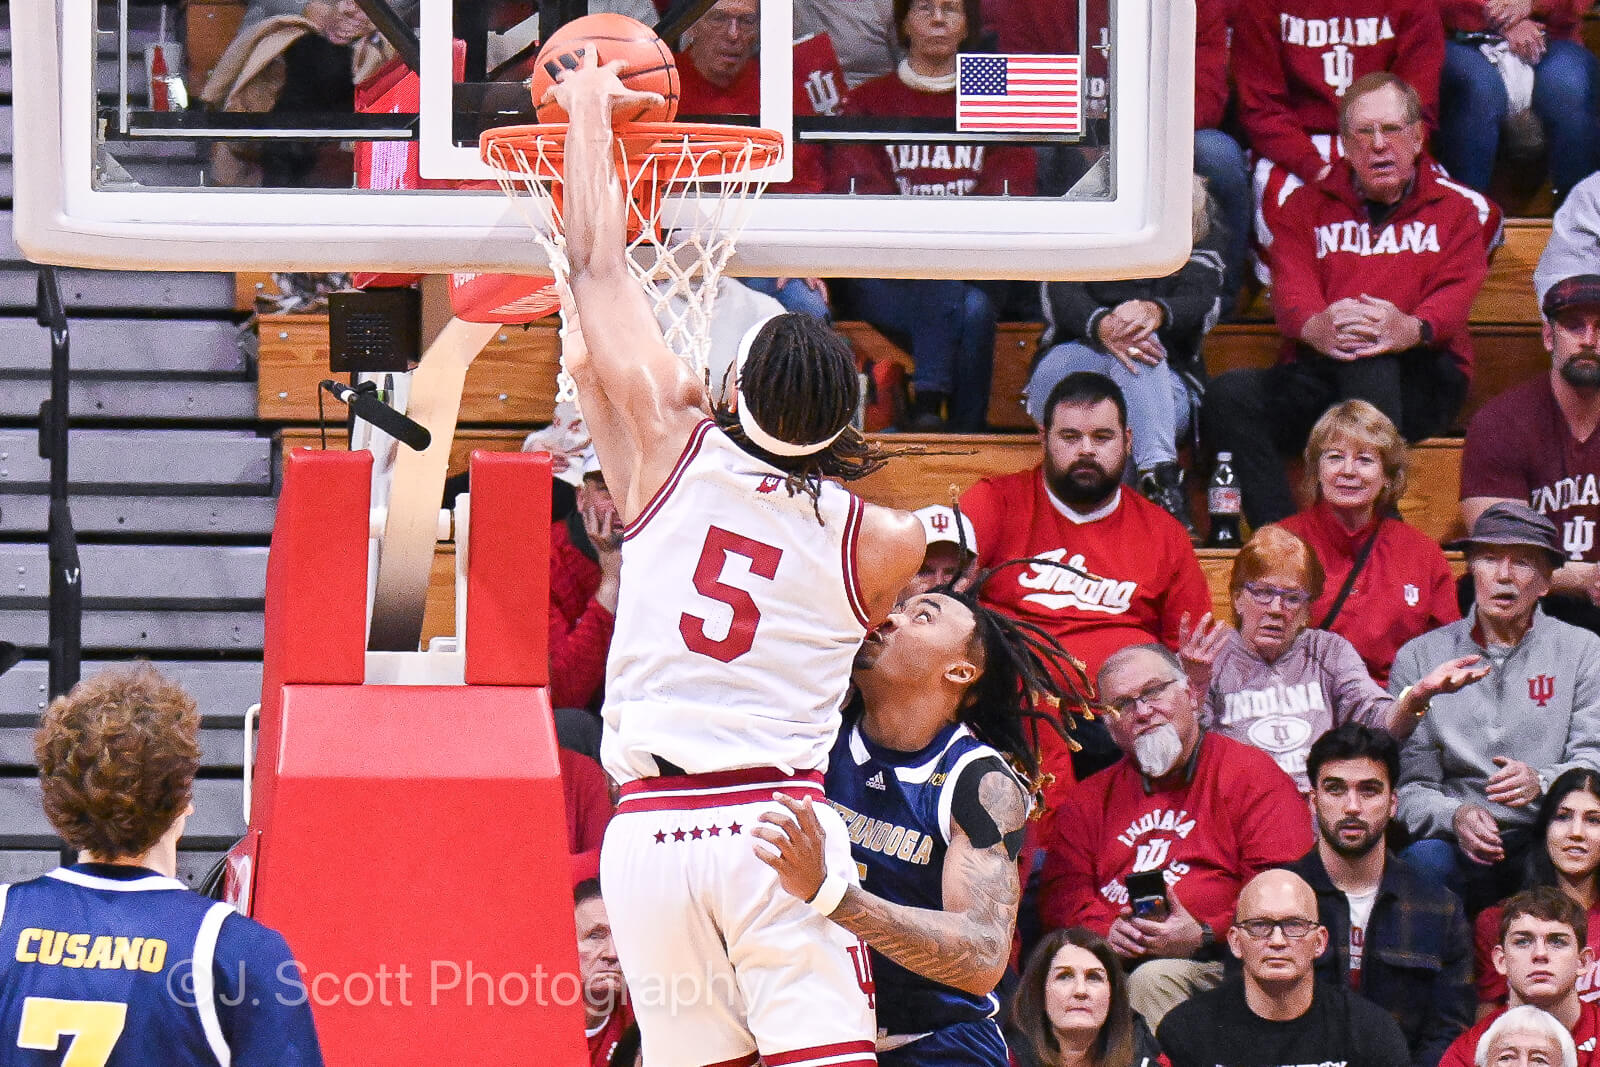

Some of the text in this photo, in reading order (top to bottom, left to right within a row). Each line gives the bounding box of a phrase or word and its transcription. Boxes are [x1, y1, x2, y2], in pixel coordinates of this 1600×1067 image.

[1280, 12, 1395, 48] INDIANA
[1313, 219, 1440, 259] INDIANA
[1531, 473, 1600, 514] INDIA
[679, 524, 784, 664] 5
[1018, 547, 1138, 613] Indiana
[1221, 681, 1328, 726] INDIANA
[826, 798, 934, 866] TANOOGA
[1117, 808, 1197, 848] INDIANA
[15, 927, 168, 973] CUSANO
[16, 996, 128, 1067] 7
